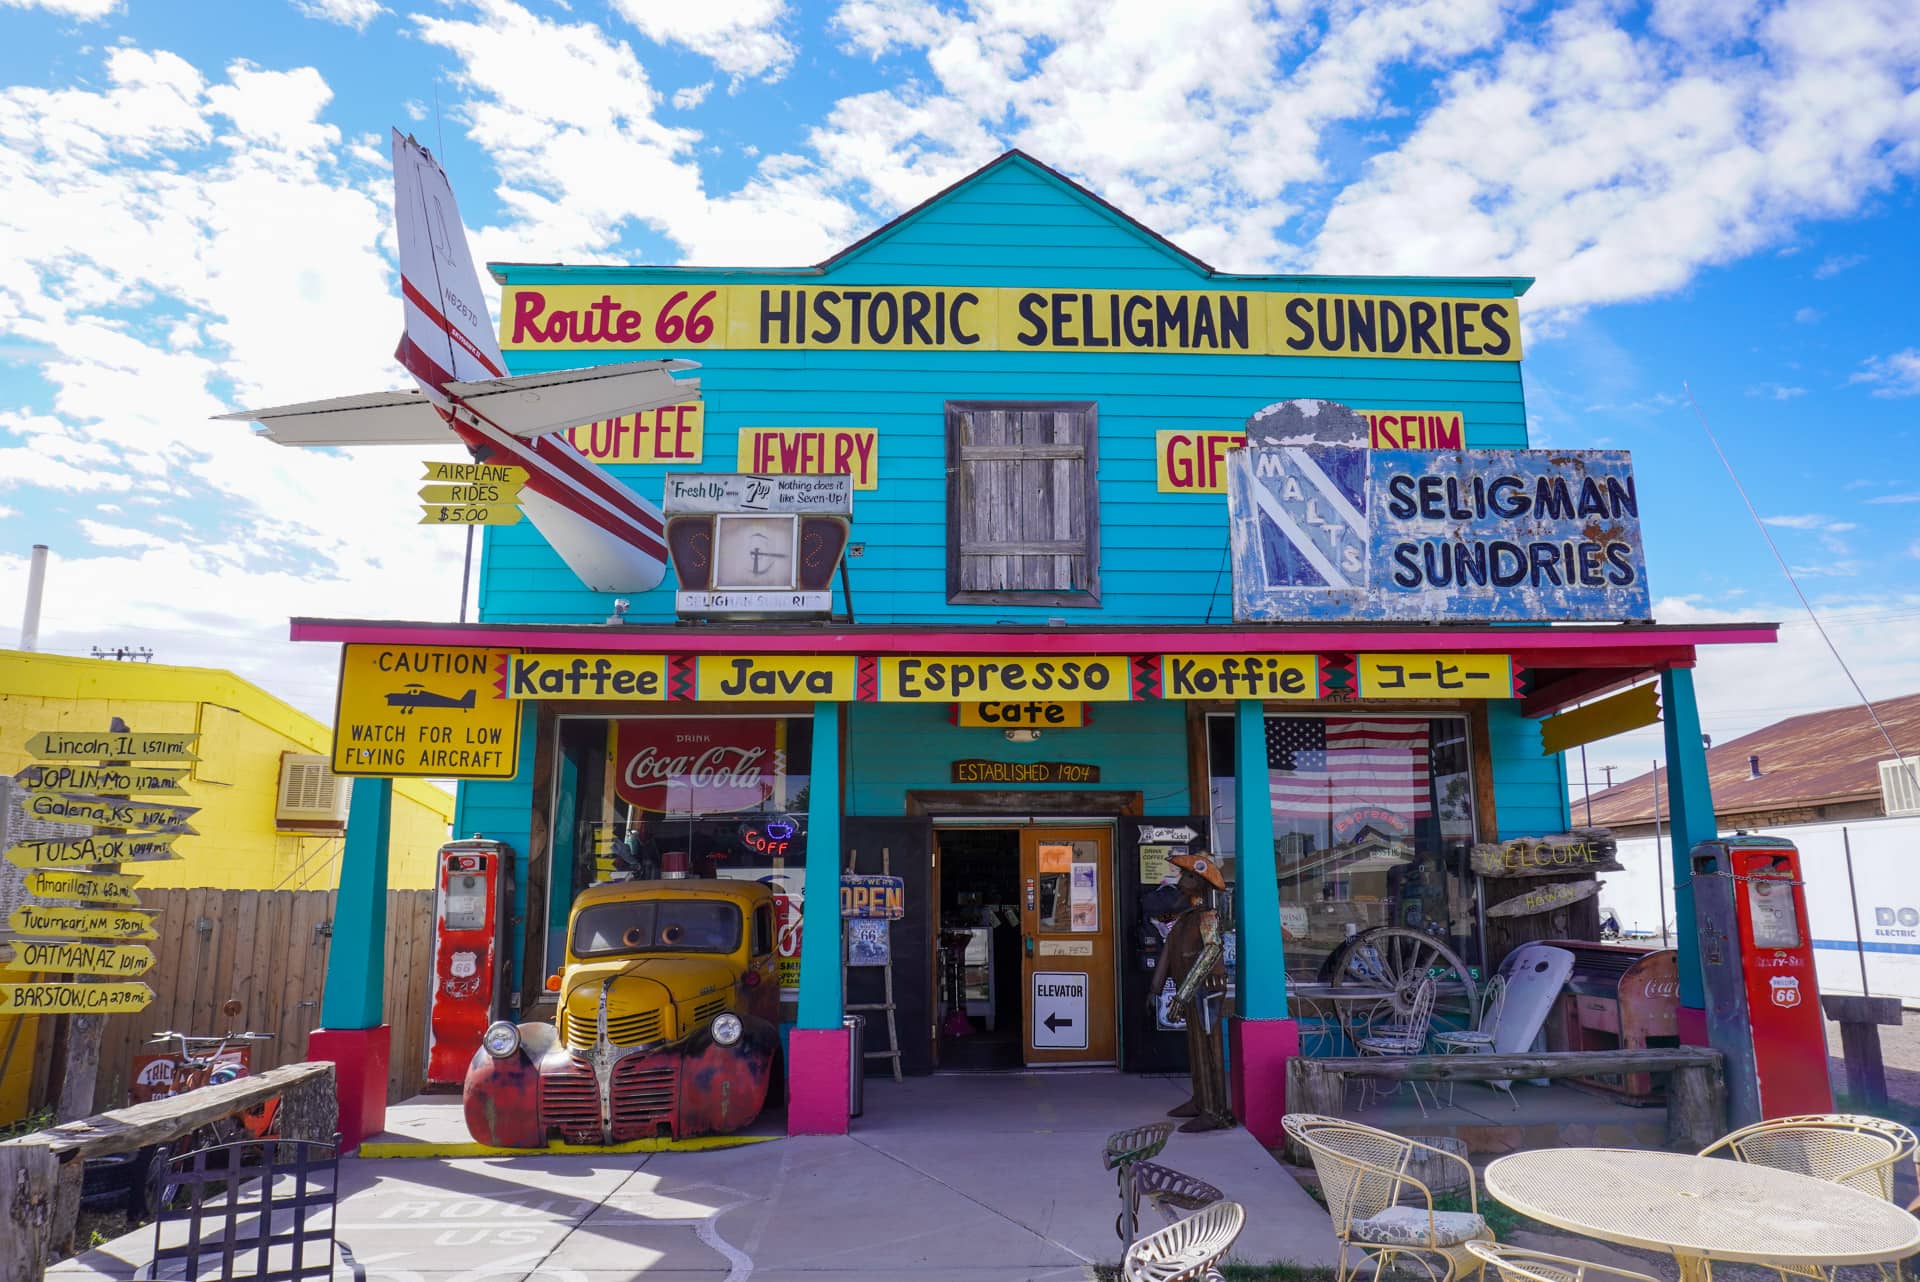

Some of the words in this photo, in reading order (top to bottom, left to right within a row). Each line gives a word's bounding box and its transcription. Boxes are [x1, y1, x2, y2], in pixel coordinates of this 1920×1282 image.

[512, 291, 641, 344] Route
[655, 290, 717, 344] 66
[760, 289, 979, 346] HISTORIC
[1017, 292, 1249, 349] SELIGMAN
[1285, 297, 1510, 356] SUNDRIES
[753, 432, 874, 484] JEWELRY
[436, 464, 512, 482] AIRPLANE
[451, 486, 499, 502] RIDES
[778, 481, 812, 493] Nothing
[813, 481, 833, 490] does
[834, 481, 843, 490] it
[779, 493, 795, 504] like
[1388, 475, 1639, 521] SELIGMAN
[439, 506, 488, 522] $5.00
[1255, 452, 1363, 573] MALTS
[1393, 541, 1636, 588] SUNDRIES
[379, 651, 487, 674] CAUTION
[514, 659, 659, 695] Kaffee
[720, 658, 833, 695] Java
[898, 658, 1110, 698] Espresso
[1172, 657, 1306, 695] Koffie
[1376, 660, 1490, 690] コーヒー
[351, 725, 406, 742] WATCH
[419, 726, 453, 743] FOR
[466, 727, 502, 745] LOW
[676, 734, 711, 743] DRINK
[45, 735, 113, 757] Lincoln,
[114, 736, 137, 755] IL
[346, 748, 406, 766] FLYING
[419, 750, 503, 768] AIRCRAFT
[624, 746, 767, 789] Coca-Cola
[959, 763, 1050, 782] ESTABLISHED
[1058, 764, 1089, 782] 1904
[112, 807, 133, 823] KS
[745, 831, 789, 855] COFF
[1482, 842, 1601, 870] WELCOME
[841, 886, 903, 917] OPEN
[860, 929, 877, 941] 66
[1874, 929, 1917, 938] ELECTRIC
[455, 962, 472, 973] 66
[1037, 984, 1083, 998] ELEVATOR
[1776, 989, 1796, 1002] 66
[433, 1228, 546, 1246] US
